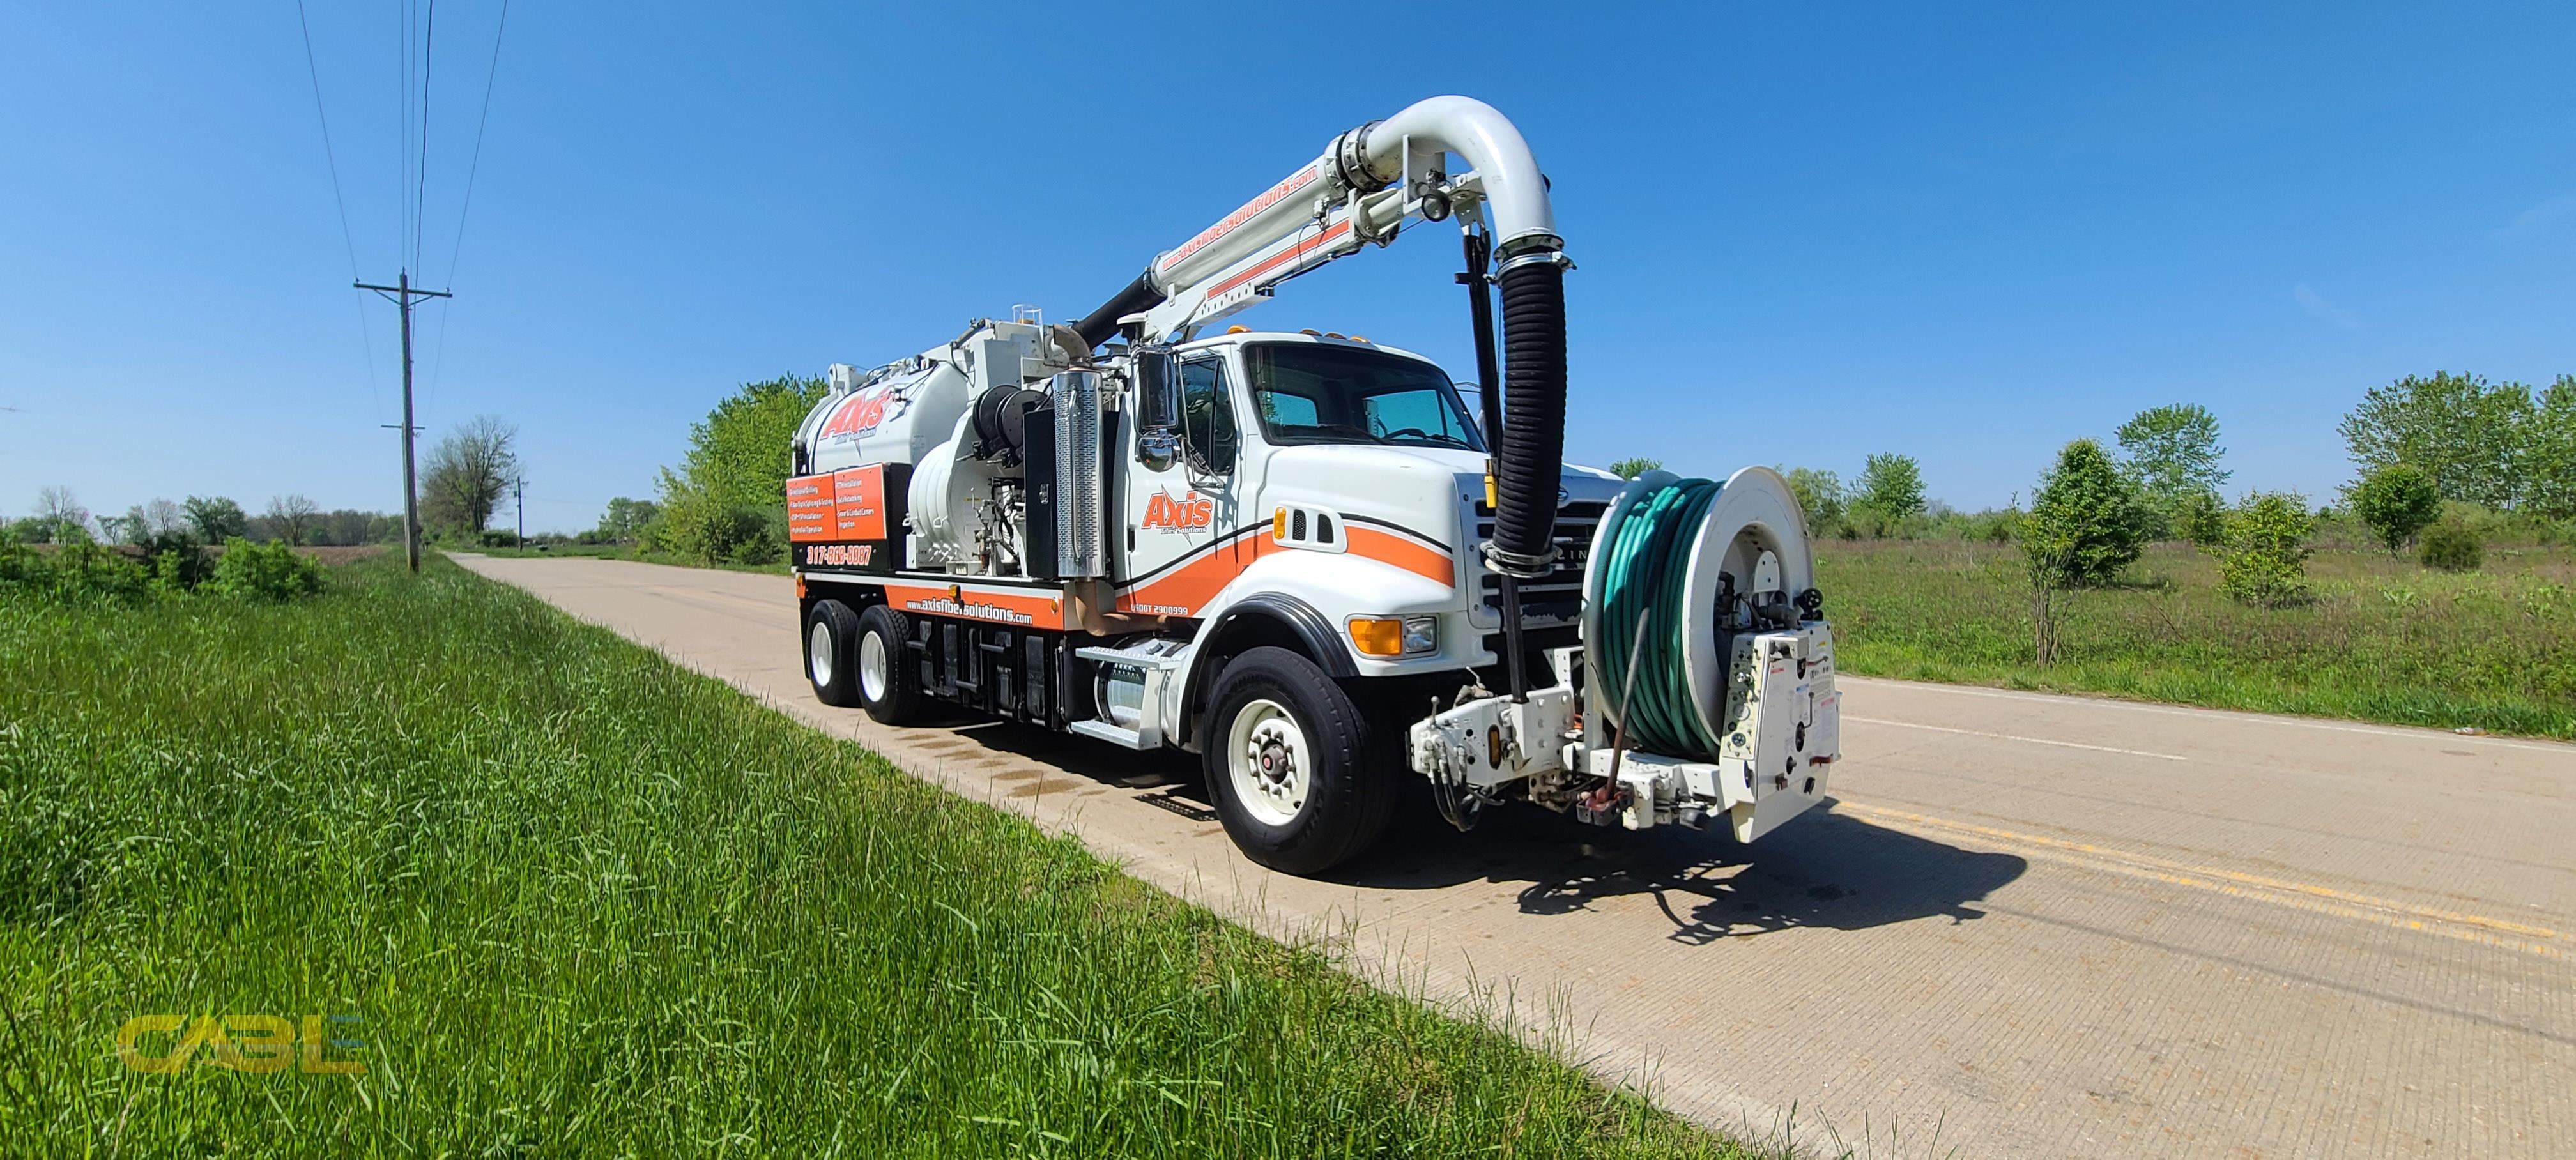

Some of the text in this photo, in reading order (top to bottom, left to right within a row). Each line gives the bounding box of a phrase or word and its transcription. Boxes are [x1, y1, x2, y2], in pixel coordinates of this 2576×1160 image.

[1142, 484, 1213, 529] Axis
[907, 598, 1033, 625] www.axisfibesolutions.com
[1153, 605, 1188, 616] 2900999
